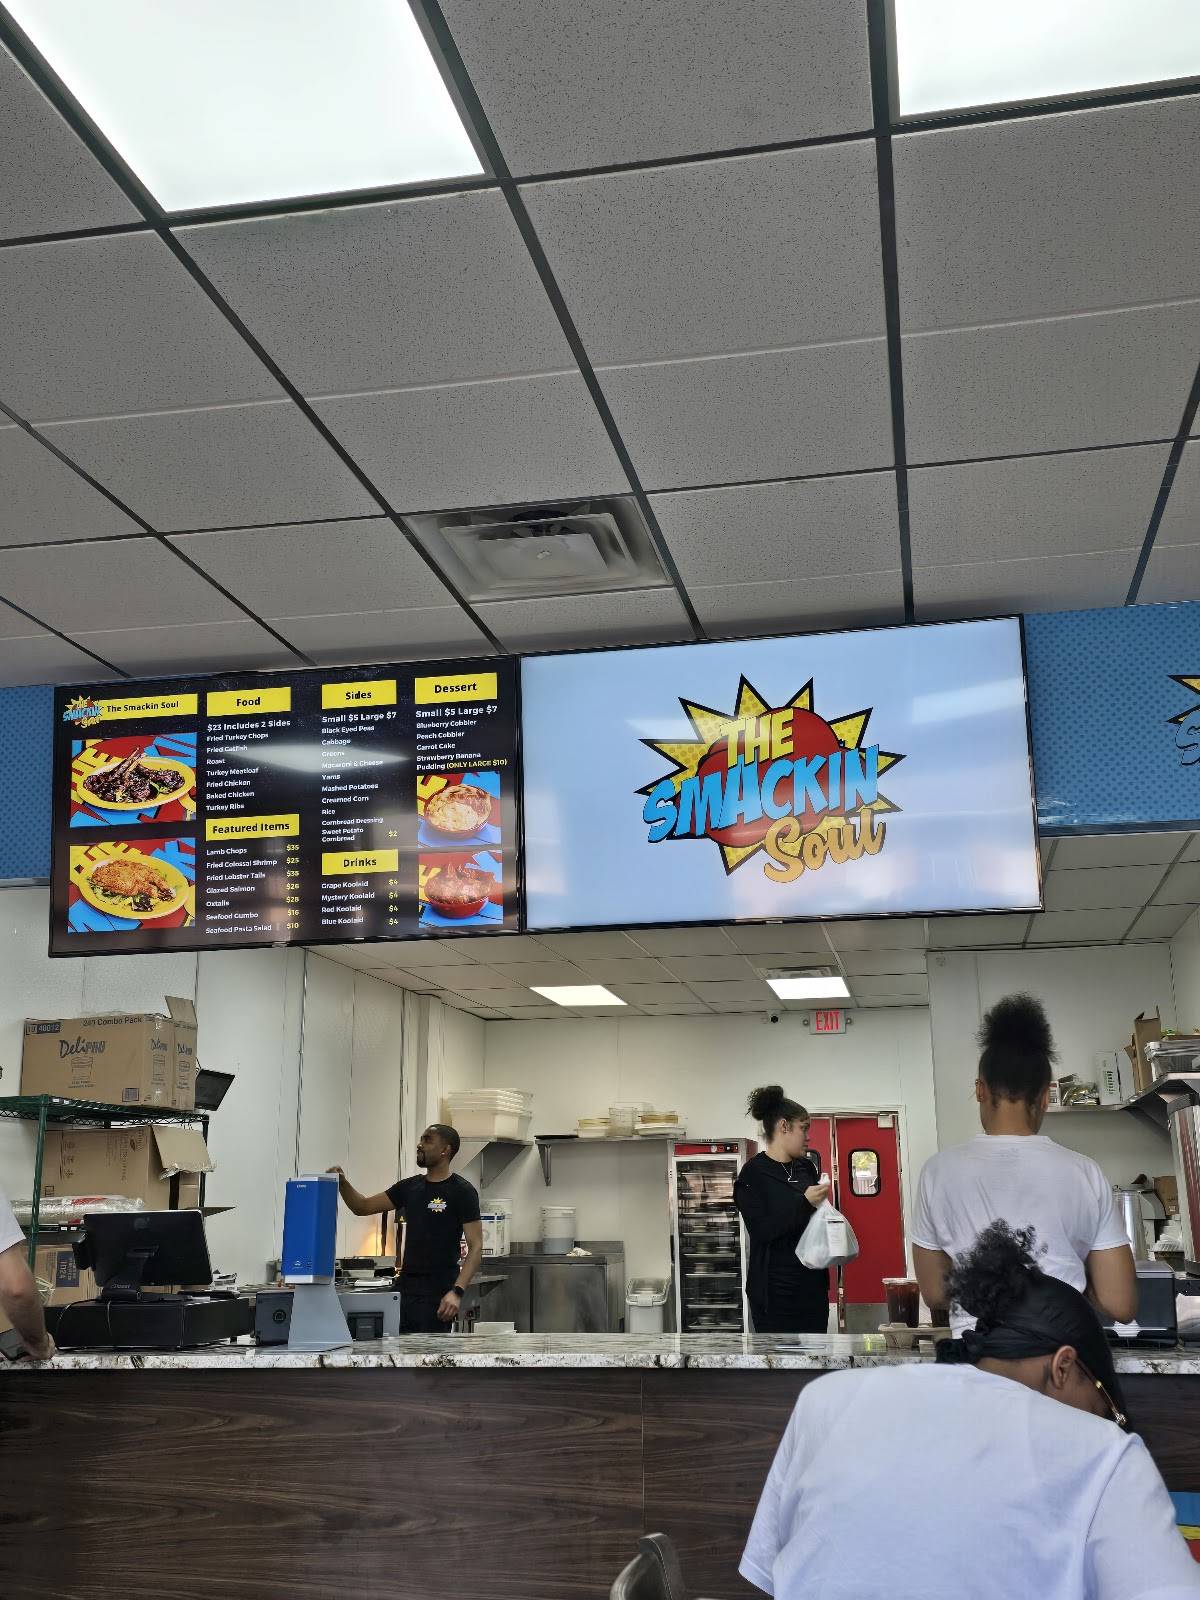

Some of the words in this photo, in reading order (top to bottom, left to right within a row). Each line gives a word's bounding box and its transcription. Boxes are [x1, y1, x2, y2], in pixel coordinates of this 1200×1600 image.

[434, 682, 477, 693] Dessert
[346, 691, 372, 700] Sides
[124, 702, 158, 712] Smackin
[160, 701, 179, 709] Soul
[236, 697, 261, 706] Food
[415, 708, 442, 718] Small
[444, 708, 456, 717] $5
[458, 706, 484, 716] Large
[486, 704, 498, 714] $7
[322, 715, 346, 723] Small
[349, 714, 359, 722] $5
[360, 713, 384, 721] Large
[224, 722, 259, 730] Includes
[341, 726, 358, 734] Eyed
[416, 732, 437, 740] Peach
[719, 708, 794, 768] THE
[468, 760, 492, 768] LARGE
[492, 758, 507, 766] $10)
[322, 784, 348, 792] Mashed
[642, 744, 879, 843] SMACKIN
[321, 796, 352, 804] Creamed
[212, 824, 258, 834] Featured
[261, 822, 290, 831] Items
[763, 807, 887, 883] Soul
[224, 860, 252, 868] Colossal
[343, 858, 377, 867] Drinks
[321, 894, 348, 902] Mystery
[97, 1018, 123, 1026] Combo
[124, 1016, 142, 1024] Pack
[816, 1012, 840, 1030] EXIT
